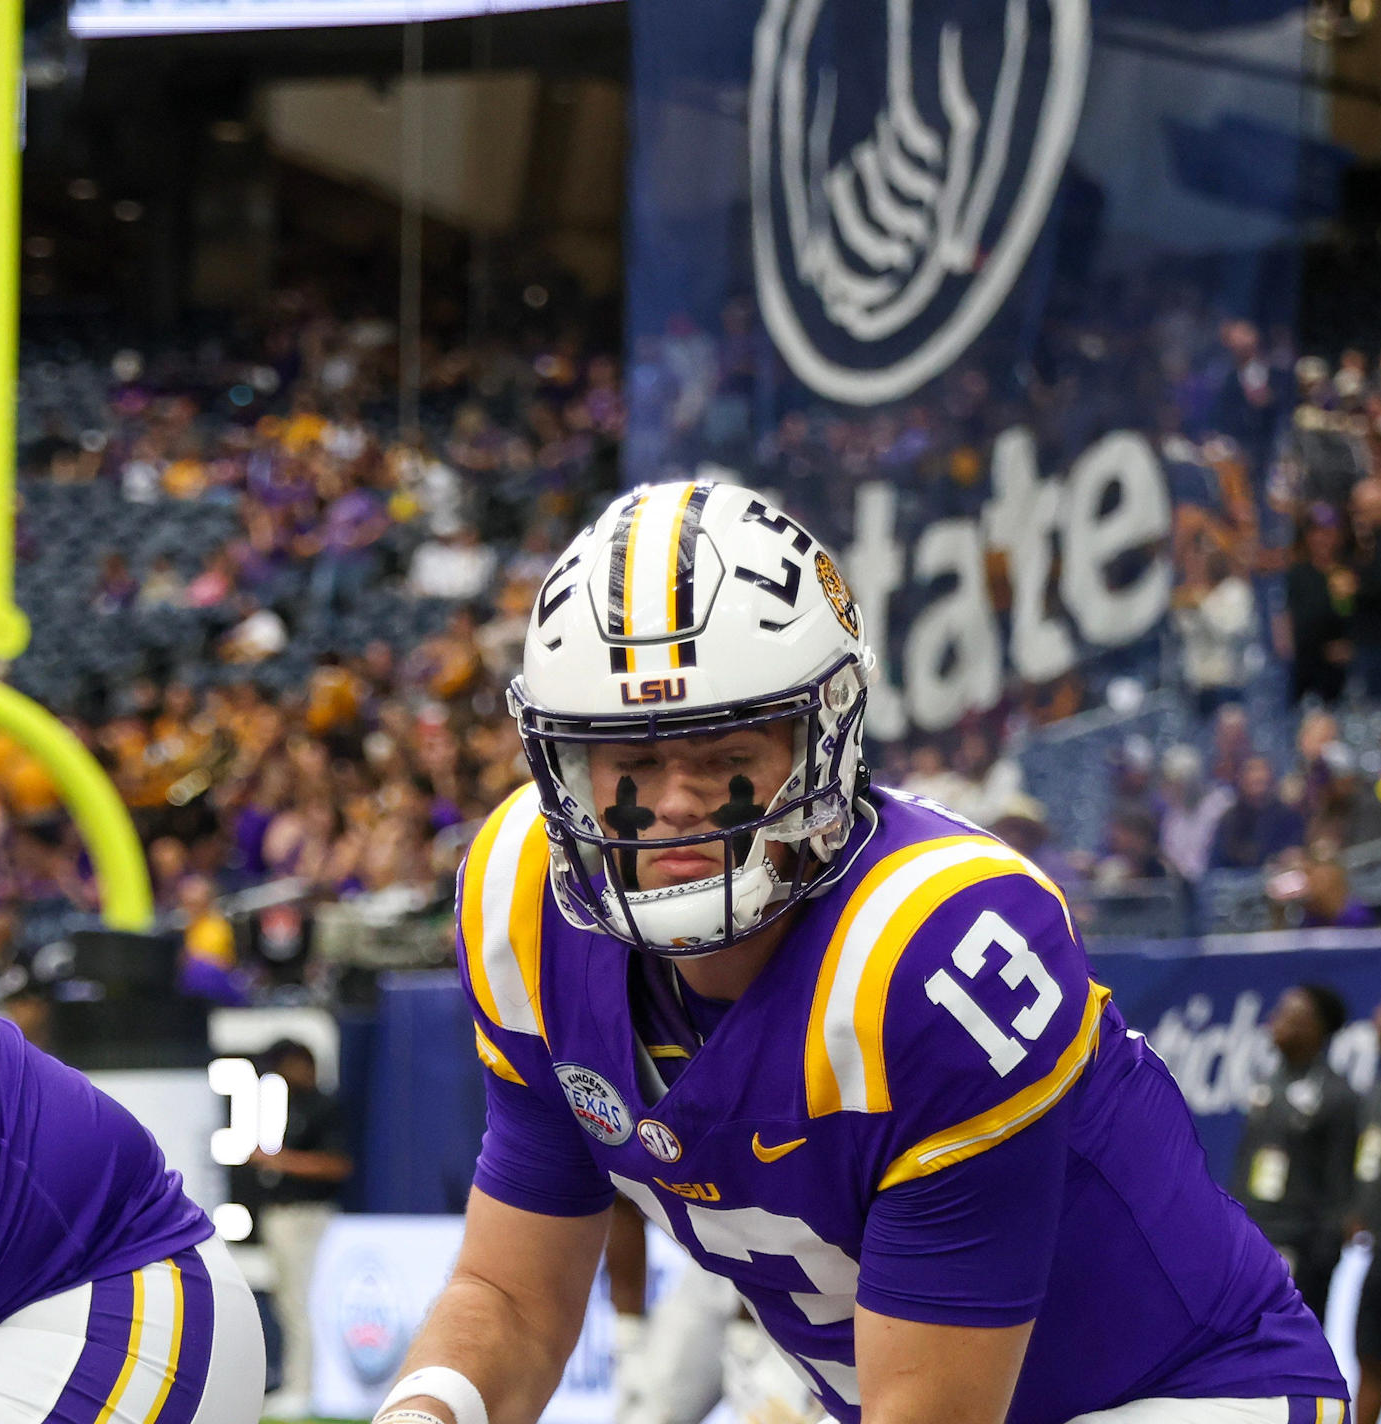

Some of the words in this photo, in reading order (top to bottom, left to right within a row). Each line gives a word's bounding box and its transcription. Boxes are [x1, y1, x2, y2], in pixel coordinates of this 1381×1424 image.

[620, 677, 687, 706] LSU
[924, 910, 1063, 1079] 13
[640, 1122, 678, 1160] SEC
[652, 1177, 722, 1202] LSU
